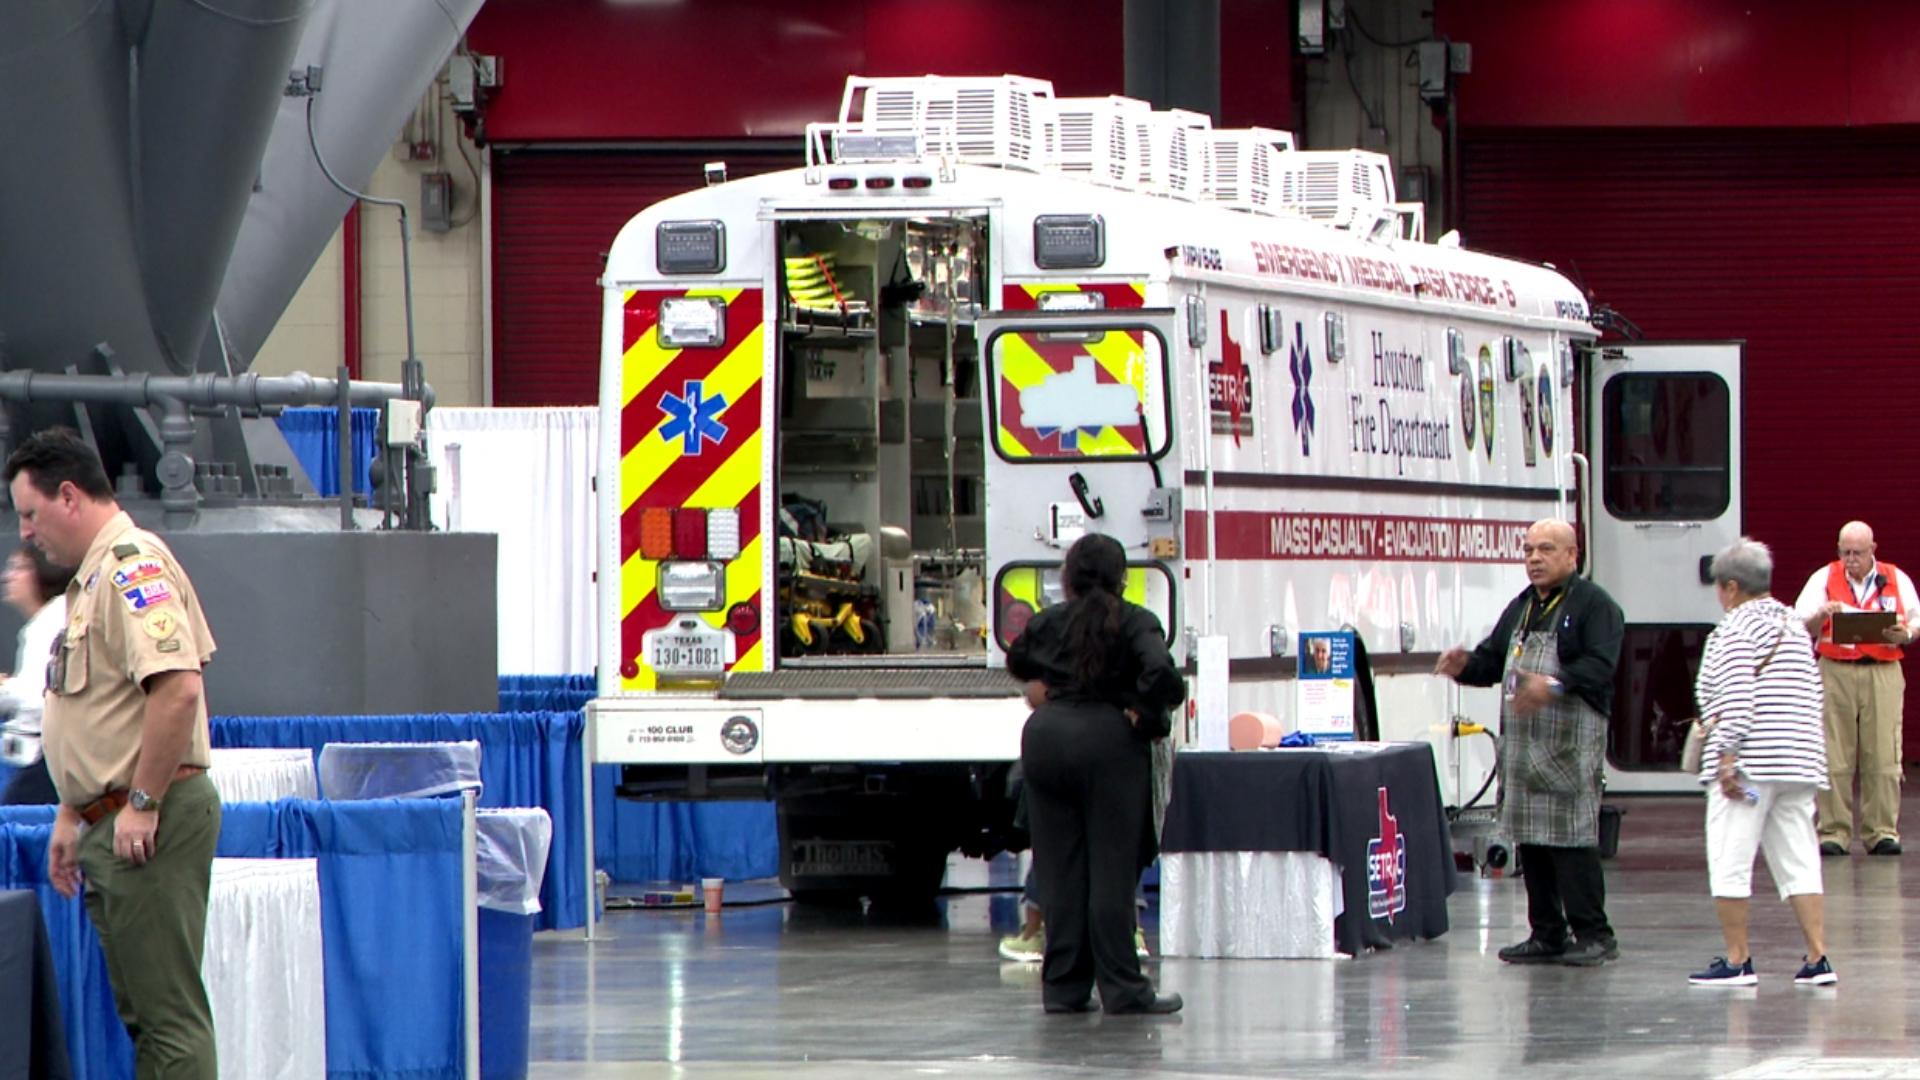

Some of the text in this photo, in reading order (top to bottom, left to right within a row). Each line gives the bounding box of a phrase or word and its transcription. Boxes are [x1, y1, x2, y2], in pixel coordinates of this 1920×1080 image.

[1251, 241, 1345, 283] EMERGENCY
[1346, 255, 1411, 293] MEDICAL
[1449, 271, 1497, 305] FORCE
[1371, 330, 1425, 392] Houston
[1351, 394, 1452, 475] Fire Department
[1271, 517, 1310, 555] MASS
[1312, 518, 1377, 556] CASUALTY
[1384, 520, 1458, 557] EVACUATION
[1459, 523, 1527, 559] AMBULANCE
[674, 636, 703, 645] TEXAS
[647, 725, 664, 735] 100
[665, 725, 693, 735] CLUB
[1369, 847, 1403, 882] SETRAC
